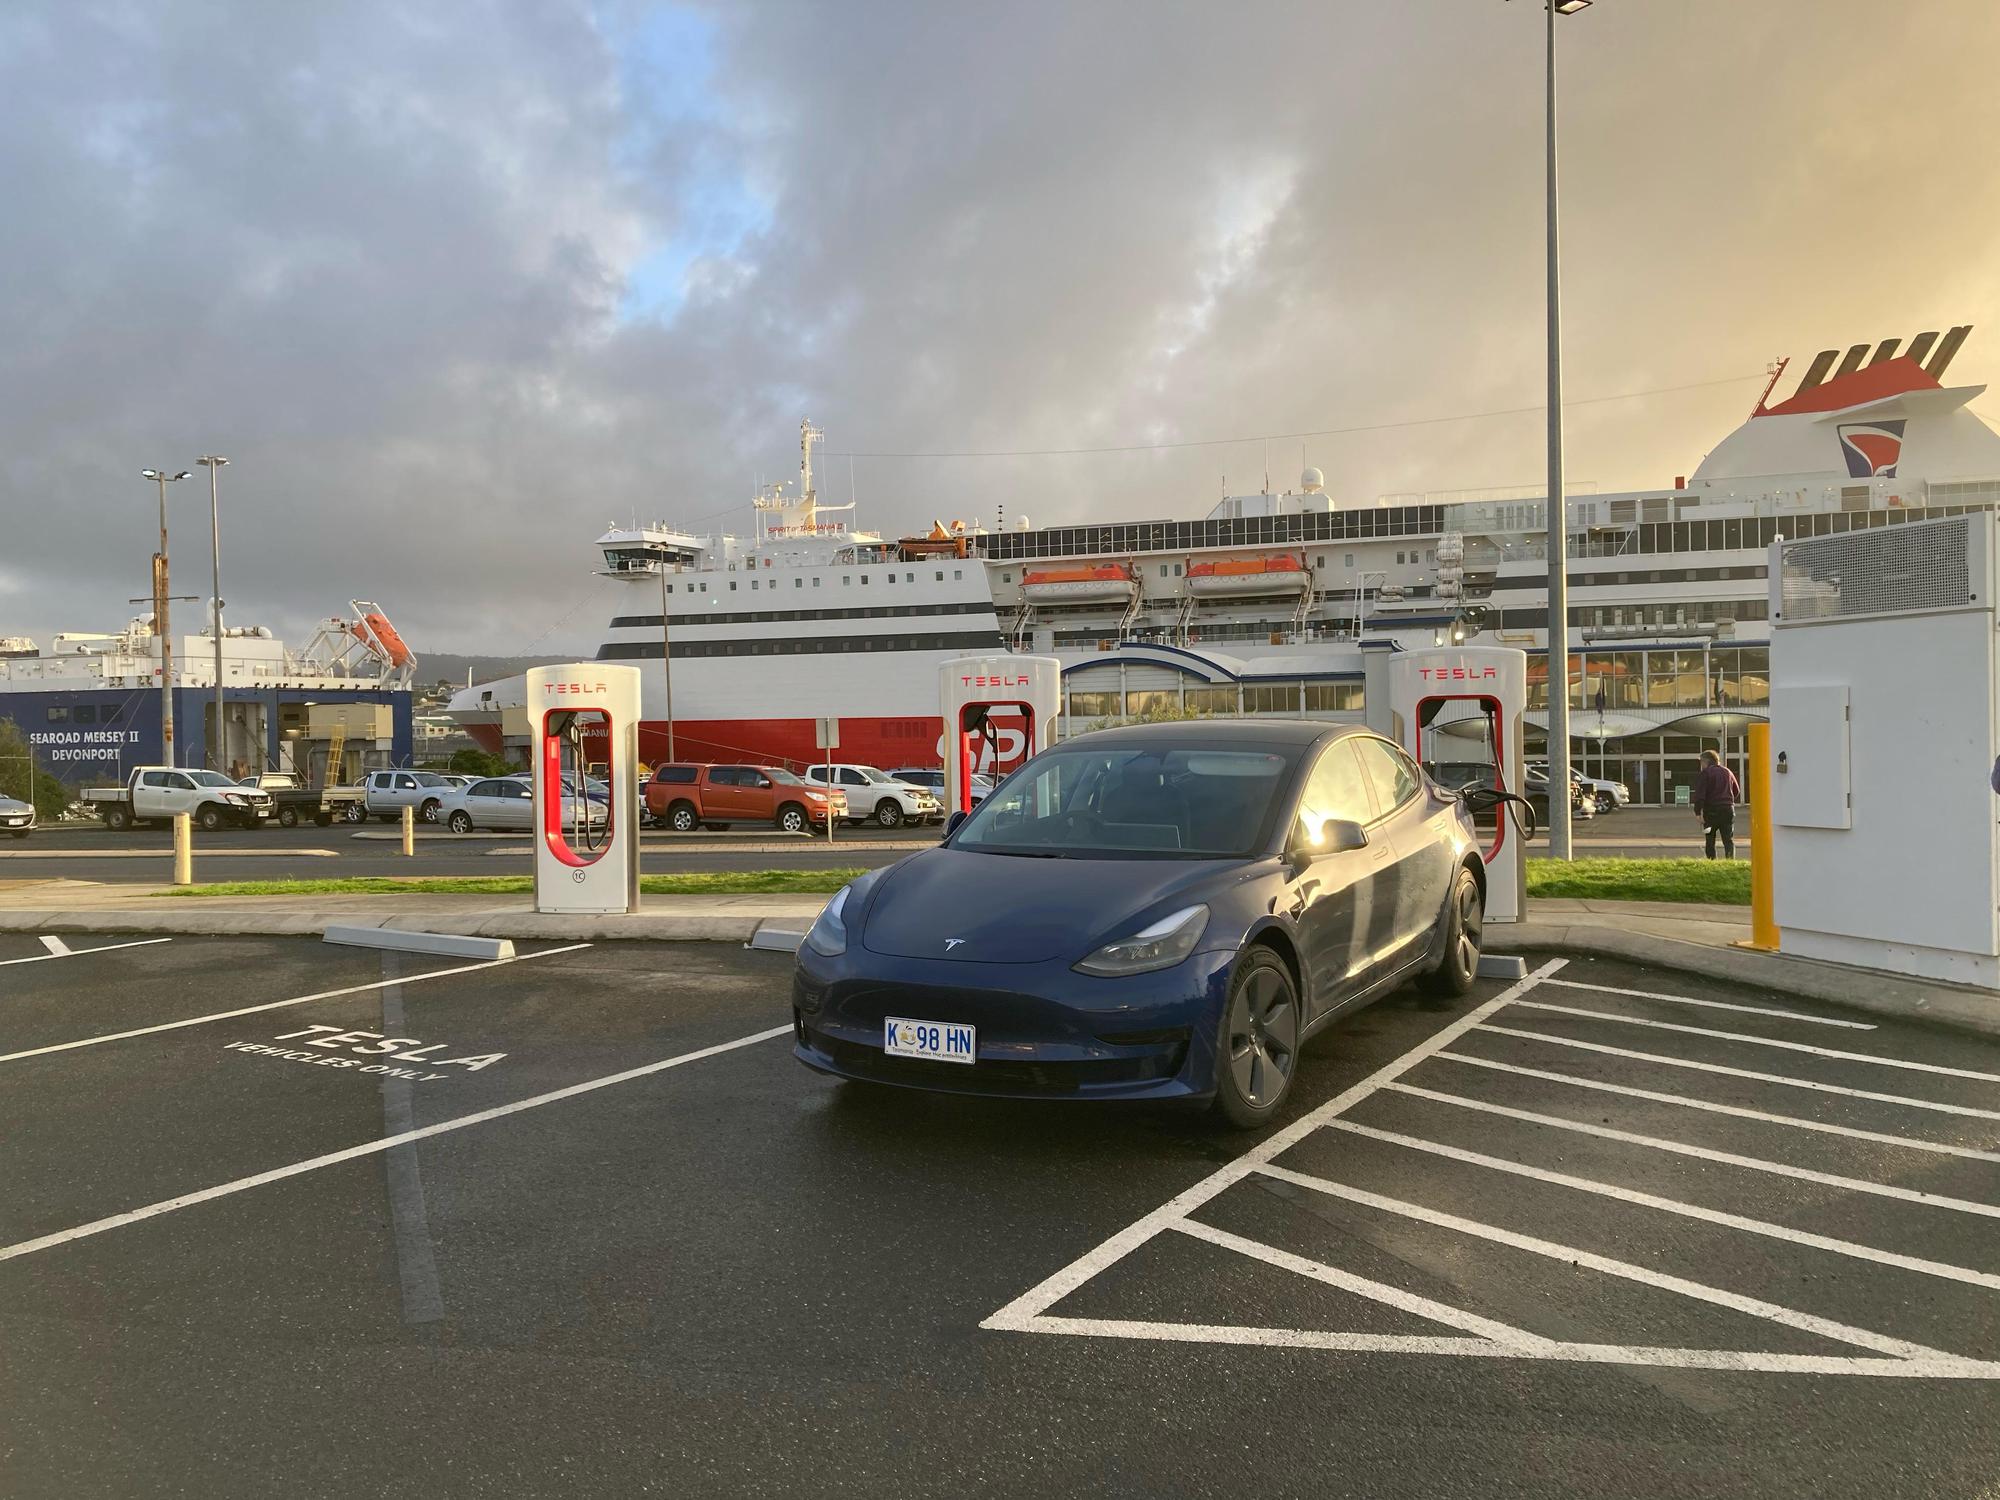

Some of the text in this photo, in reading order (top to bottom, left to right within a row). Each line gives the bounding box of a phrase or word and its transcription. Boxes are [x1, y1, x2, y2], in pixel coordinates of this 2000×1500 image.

[768, 526, 790, 534] SPIRIT
[1419, 667, 1496, 680] TESLA
[961, 675, 1029, 687] TESLA
[544, 683, 607, 695] TESLA
[30, 730, 139, 744] SEAROAD MERSEY II
[52, 748, 120, 761] DEVONPORT
[887, 1022, 971, 1054] K 98 HN
[274, 1024, 508, 1071] TESLA
[223, 1041, 449, 1082] VEHICLES ONLY
